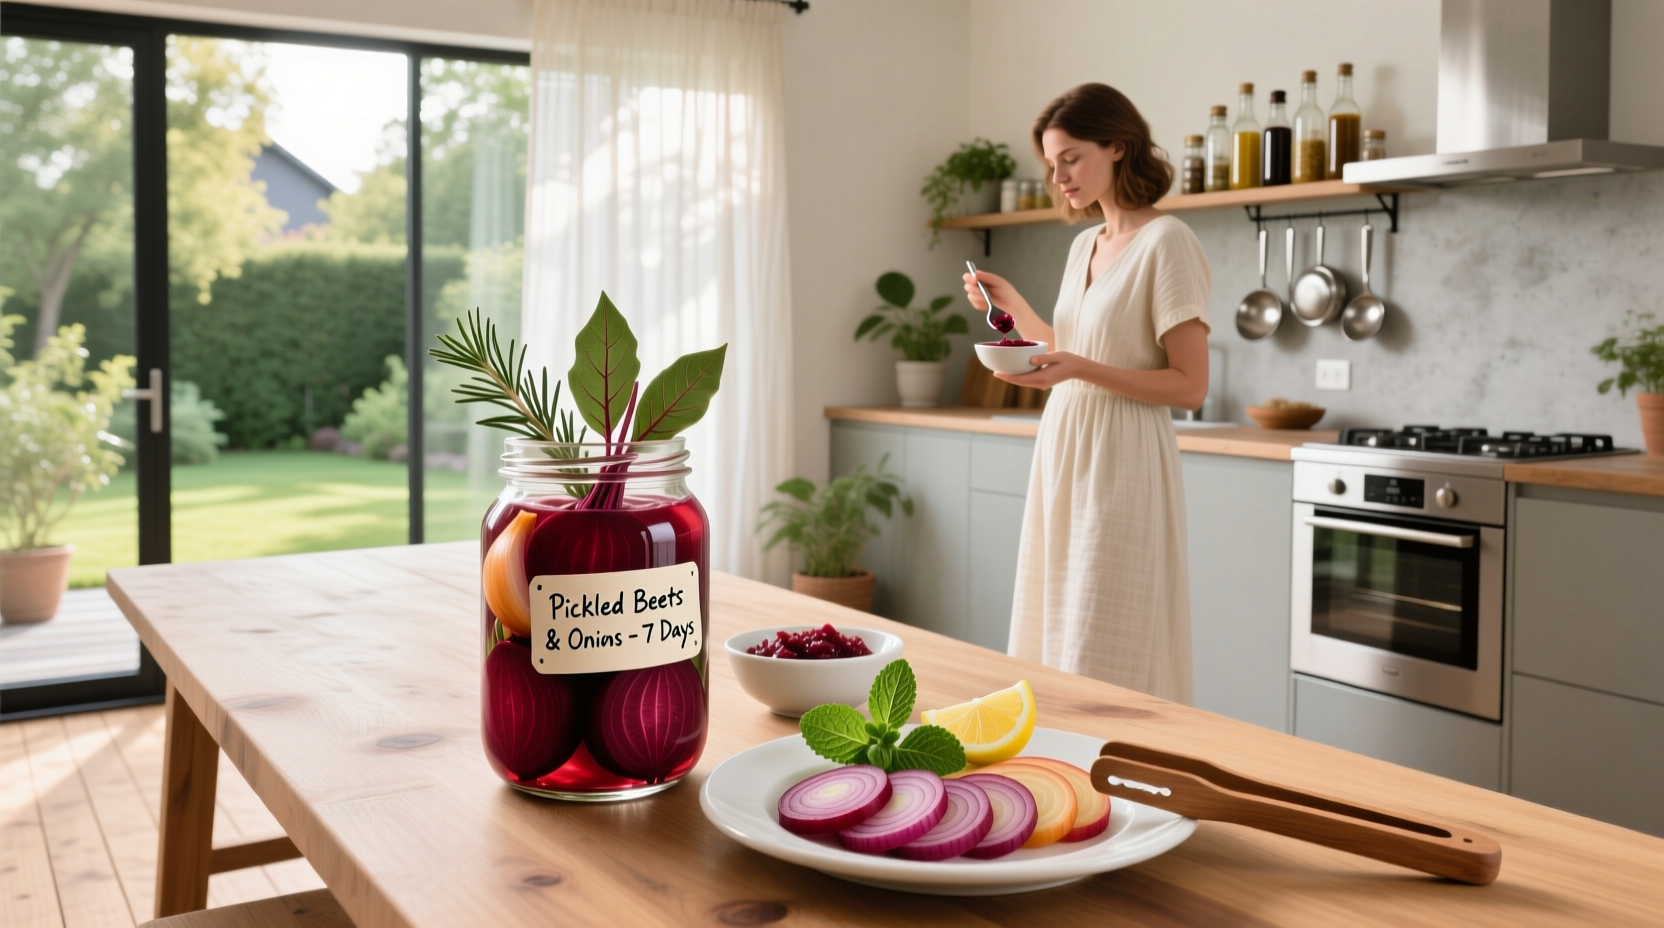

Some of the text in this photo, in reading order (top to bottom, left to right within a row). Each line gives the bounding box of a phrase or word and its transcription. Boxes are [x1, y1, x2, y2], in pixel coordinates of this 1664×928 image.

[549, 586, 684, 621] Pickled Beets
[545, 628, 561, 651] &
[641, 622, 655, 644] 7
[660, 619, 695, 650] Days
